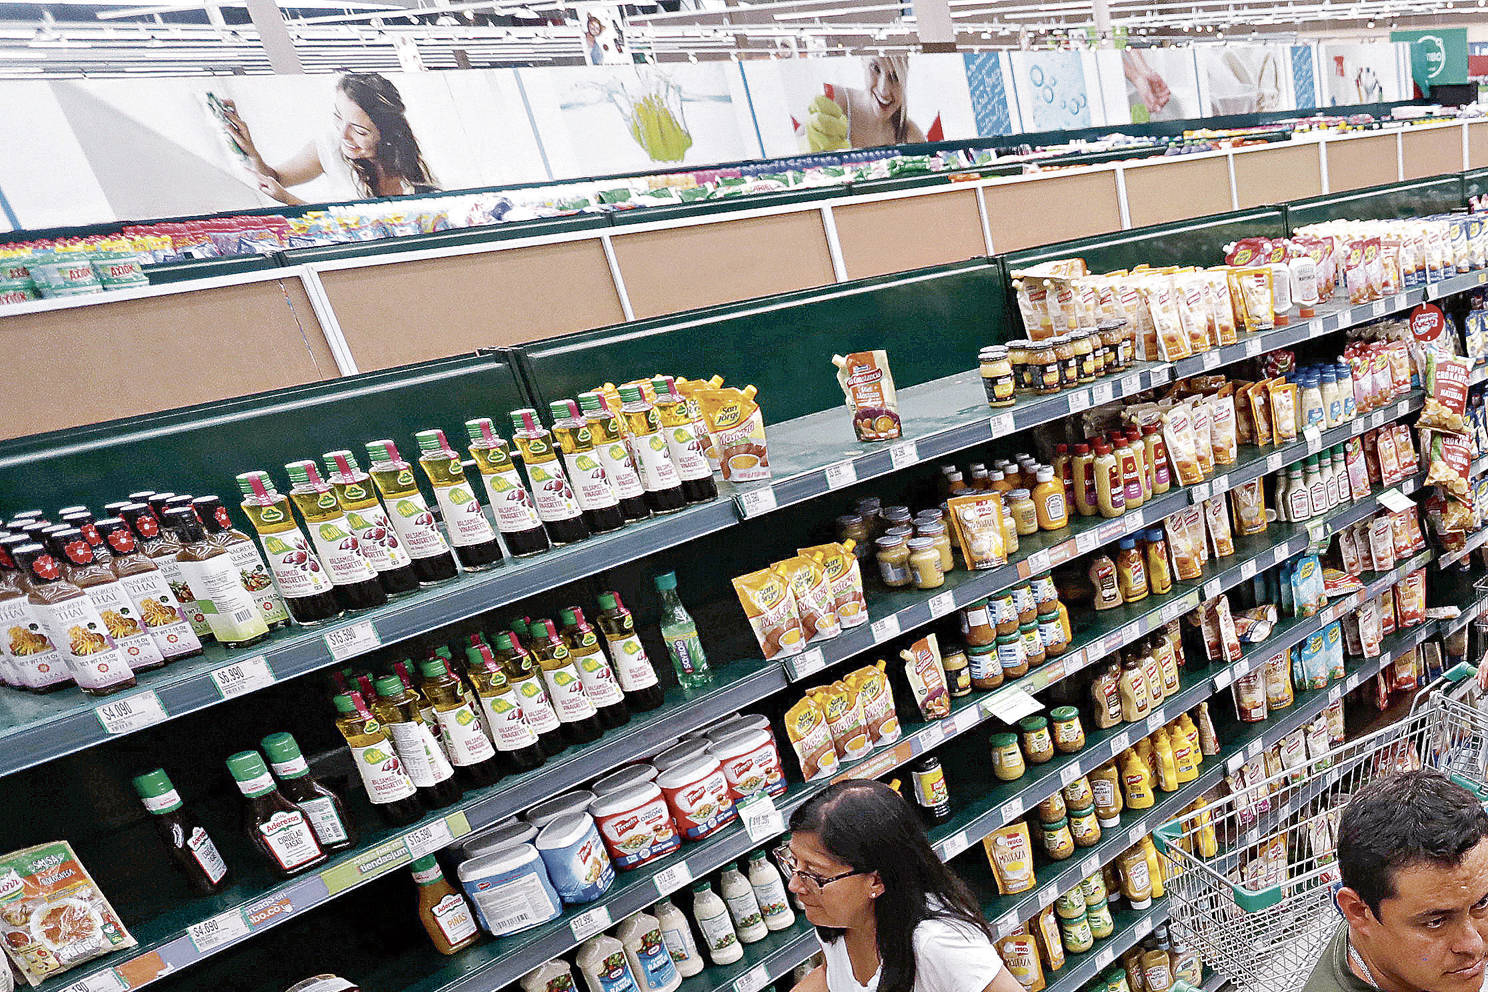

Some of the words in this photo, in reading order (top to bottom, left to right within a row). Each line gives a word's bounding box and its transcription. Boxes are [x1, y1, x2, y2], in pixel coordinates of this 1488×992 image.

[110, 264, 133, 277] AXION
[718, 411, 741, 423] Jorge
[722, 405, 738, 416] San
[720, 423, 755, 445] Mostaza
[276, 569, 299, 580] ALSAMICO
[277, 575, 308, 585] INAIGRETTE
[131, 580, 157, 595] THAI
[56, 607, 84, 622] THAI
[329, 627, 356, 647] $15.590
[216, 666, 245, 685] $6.990
[102, 701, 133, 721] $4.090
[266, 815, 299, 833] Aderezos
[408, 827, 434, 847] $15.590
[33, 854, 60, 871] SALSA
[437, 896, 462, 914] Aderezos
[193, 919, 219, 938] $4.690
[447, 911, 468, 929] PIÑAS
